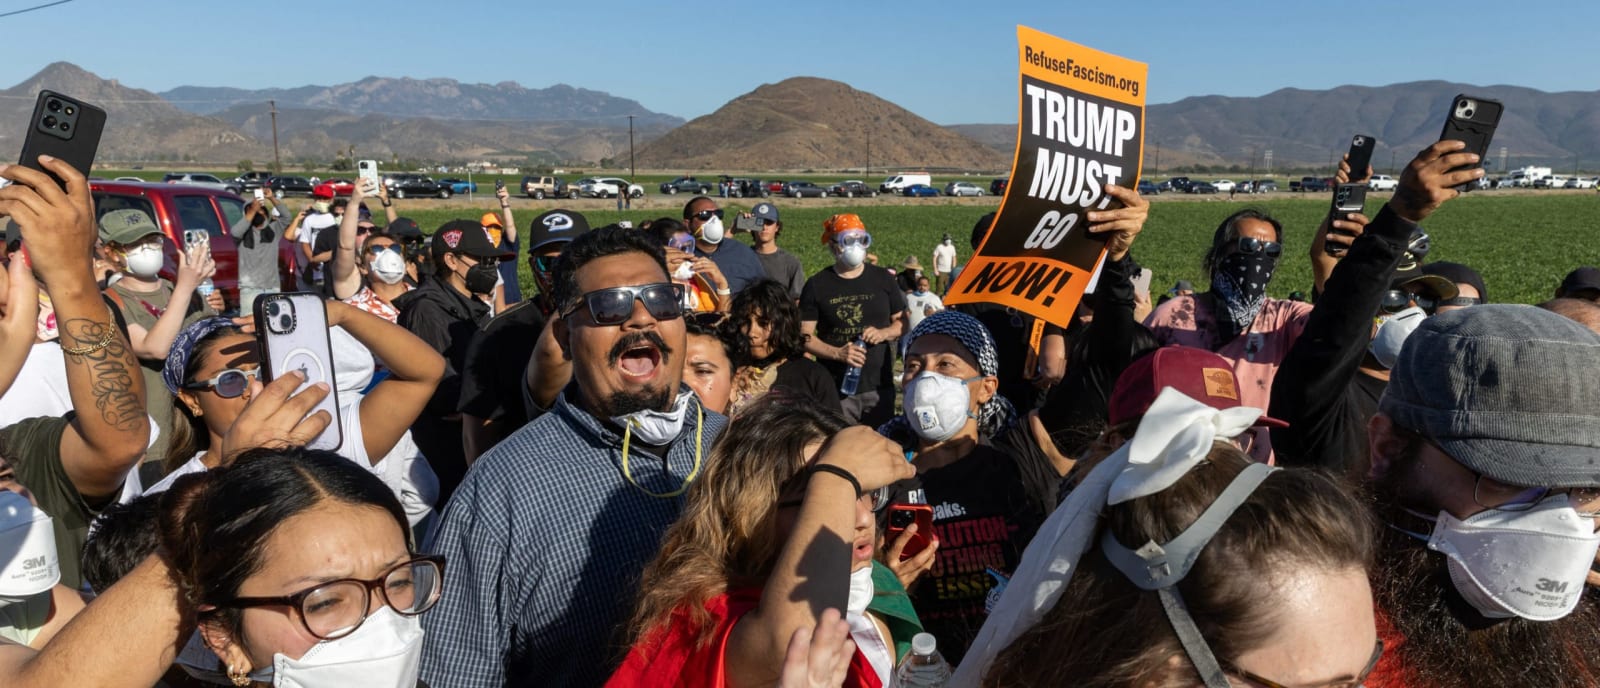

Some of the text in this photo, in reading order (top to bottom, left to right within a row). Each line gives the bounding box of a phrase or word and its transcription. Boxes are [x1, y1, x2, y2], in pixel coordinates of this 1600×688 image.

[1024, 45, 1139, 97] RefuseFascism.org
[1026, 83, 1136, 158] TRUMP
[1028, 147, 1122, 210] MUST
[1024, 210, 1078, 250] GO
[962, 260, 1073, 308] NOW!
[23, 555, 46, 570] 3M
[930, 543, 1006, 577] OTHING
[1536, 578, 1568, 593] 3M
